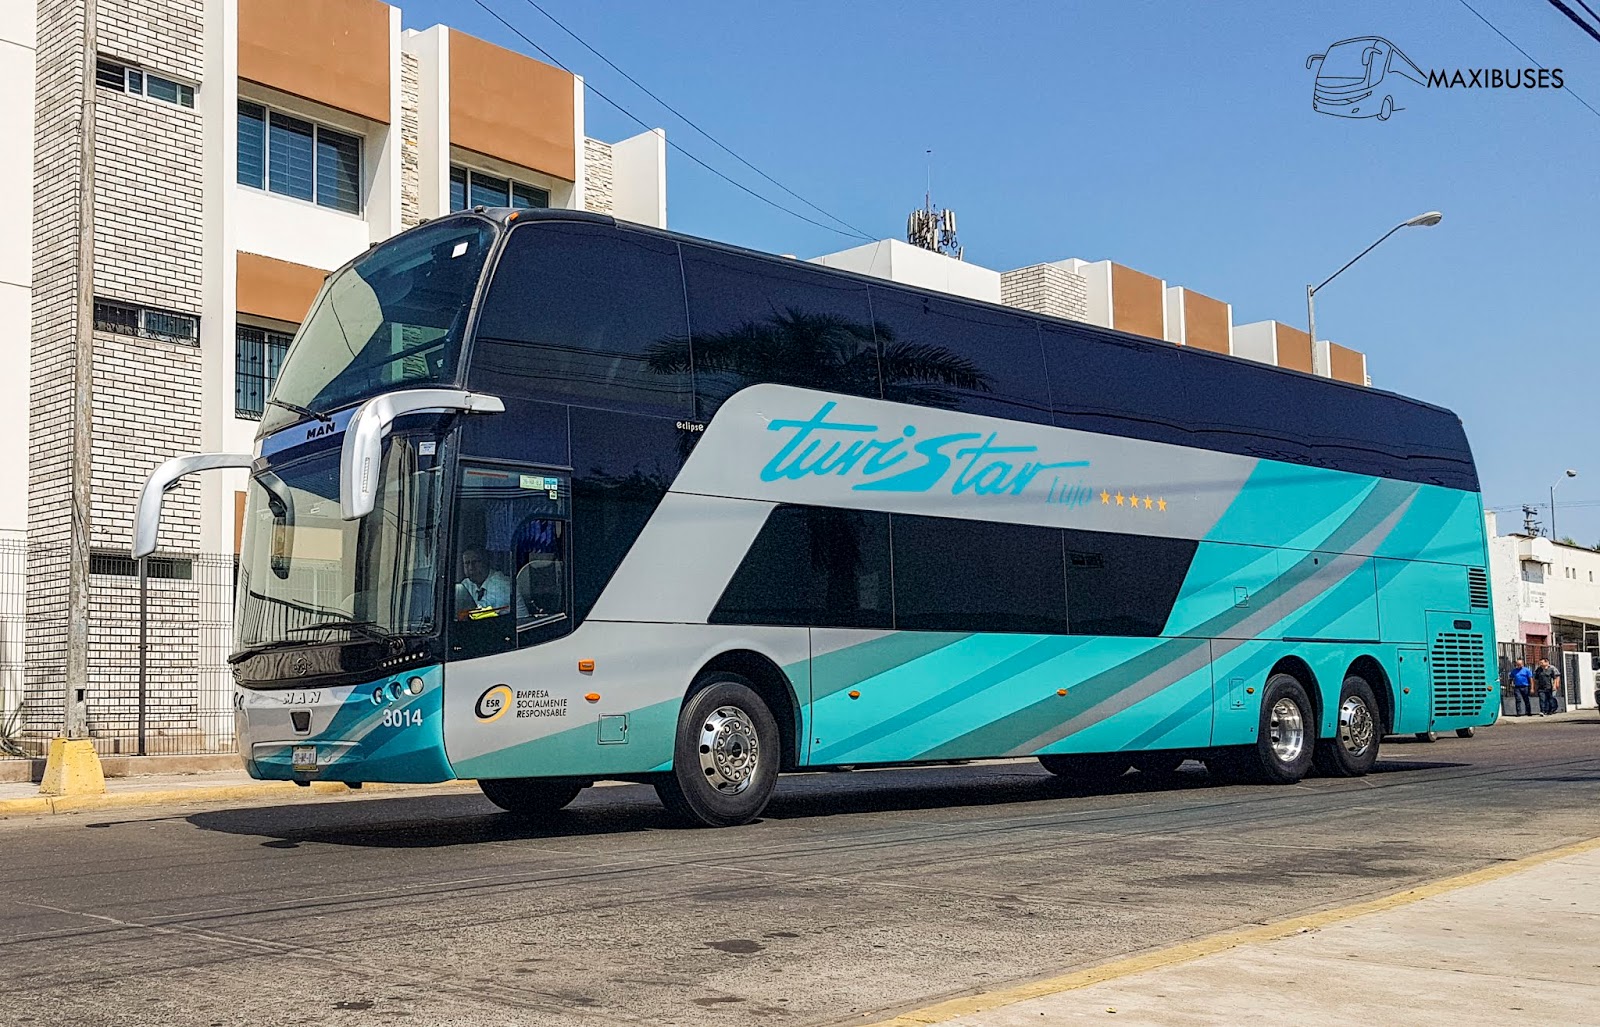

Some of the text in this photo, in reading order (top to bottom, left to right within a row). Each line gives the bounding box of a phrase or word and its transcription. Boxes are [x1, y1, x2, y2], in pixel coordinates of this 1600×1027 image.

[306, 422, 336, 440] MAN
[676, 421, 704, 433] eclipse
[282, 691, 322, 705] MAN
[516, 690, 549, 699] EMPRESA
[485, 699, 501, 708] ESR
[516, 699, 568, 709] SOCIALMENTE
[382, 708, 423, 727] 3014
[516, 708, 567, 718] RESPONSABLE
